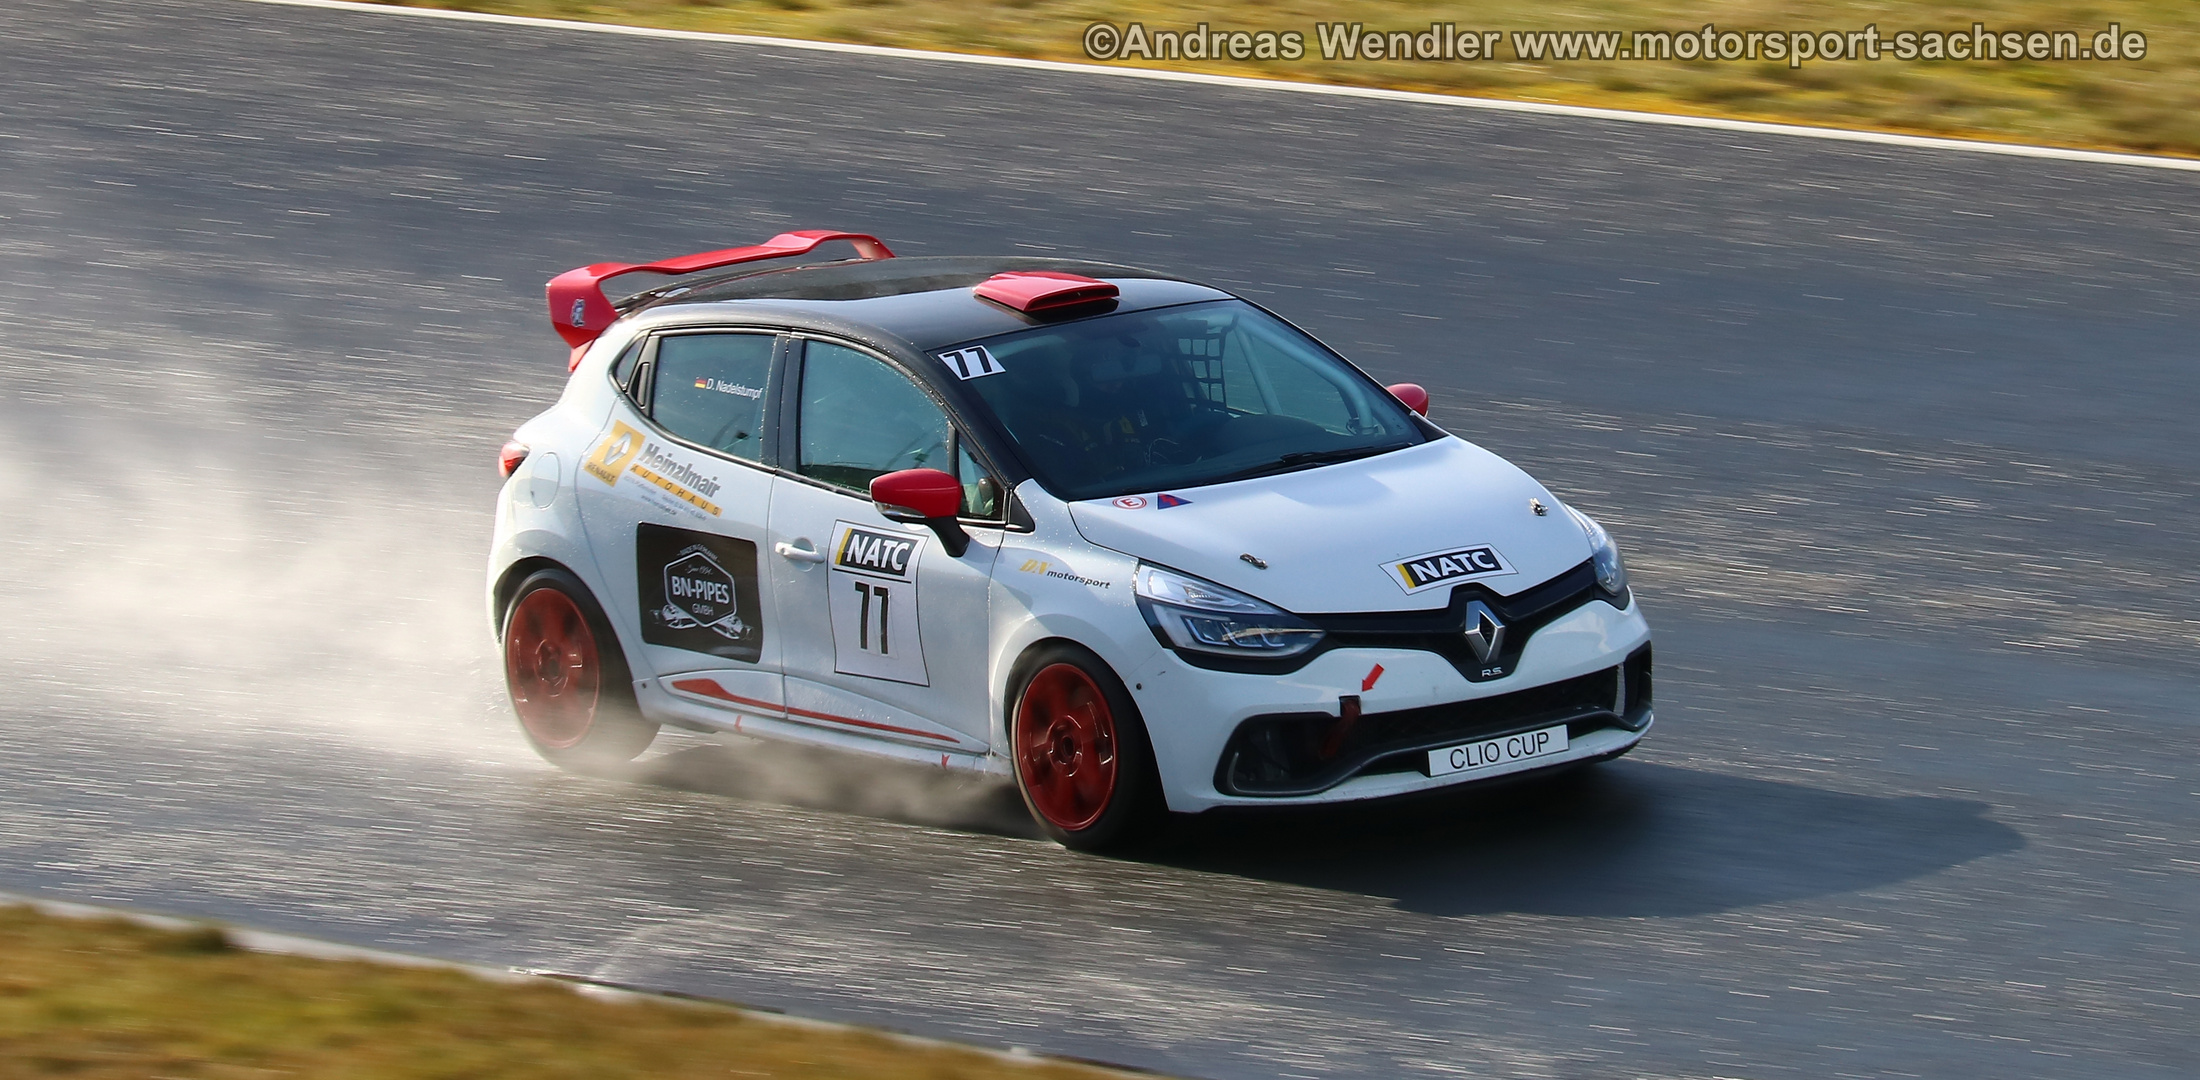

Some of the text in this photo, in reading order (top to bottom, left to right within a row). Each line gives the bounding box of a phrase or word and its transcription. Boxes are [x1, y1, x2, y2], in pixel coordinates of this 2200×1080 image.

[943, 346, 993, 378] 77
[706, 378, 764, 400] D. Nadelstumpf
[587, 461, 616, 483] RENAULT
[638, 443, 721, 498] Heinzlmair
[630, 465, 720, 516] AUTOHAUS
[846, 533, 910, 571] NATC
[1410, 551, 1495, 582] NATC
[671, 576, 729, 604] BN-PIPES
[1046, 570, 1111, 589] motorsport
[692, 603, 714, 616] GMBH
[855, 581, 889, 655] 77
[1450, 732, 1549, 769] CLIO CUP
